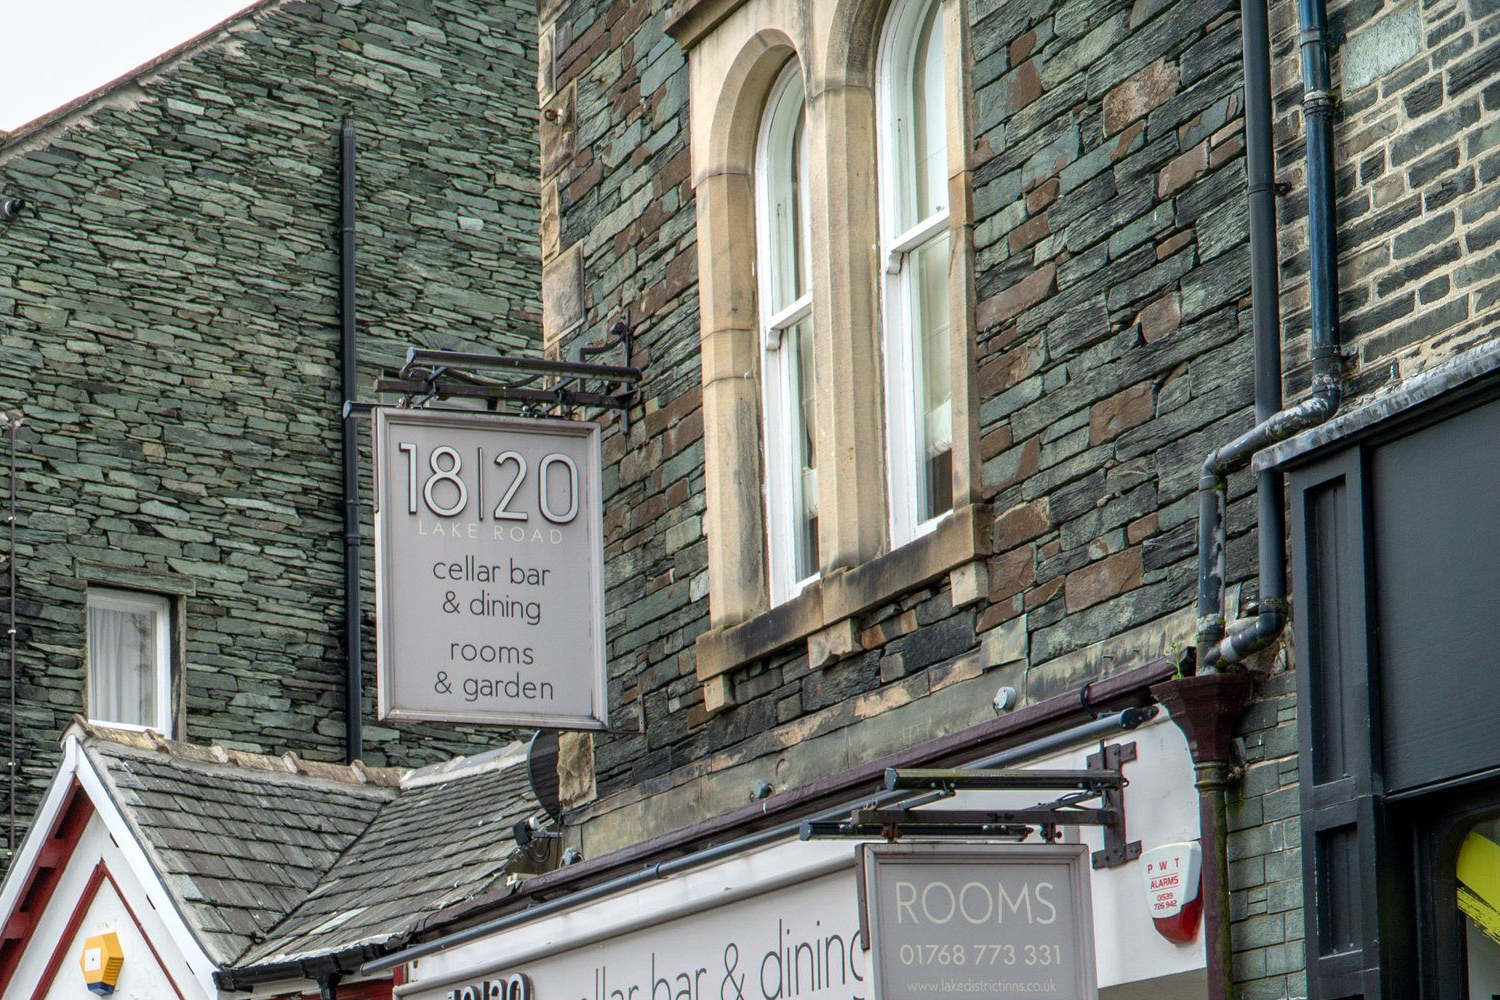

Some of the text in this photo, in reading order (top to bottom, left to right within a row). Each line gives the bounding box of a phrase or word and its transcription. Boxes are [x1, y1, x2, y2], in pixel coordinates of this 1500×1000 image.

[418, 519, 563, 545] LAKE ROAD
[432, 554, 552, 586] cellar bar
[442, 589, 541, 626] & dining
[450, 642, 534, 666] rooms
[434, 670, 554, 702] & garden
[1150, 875, 1179, 889] ALARMS
[895, 881, 1057, 924] ROOMS
[1154, 899, 1178, 911] 726 942
[1156, 892, 1174, 902] 01539
[899, 944, 1061, 966] 01768 773 331
[907, 978, 1057, 993] www.lakedistrictinns.co.uk
